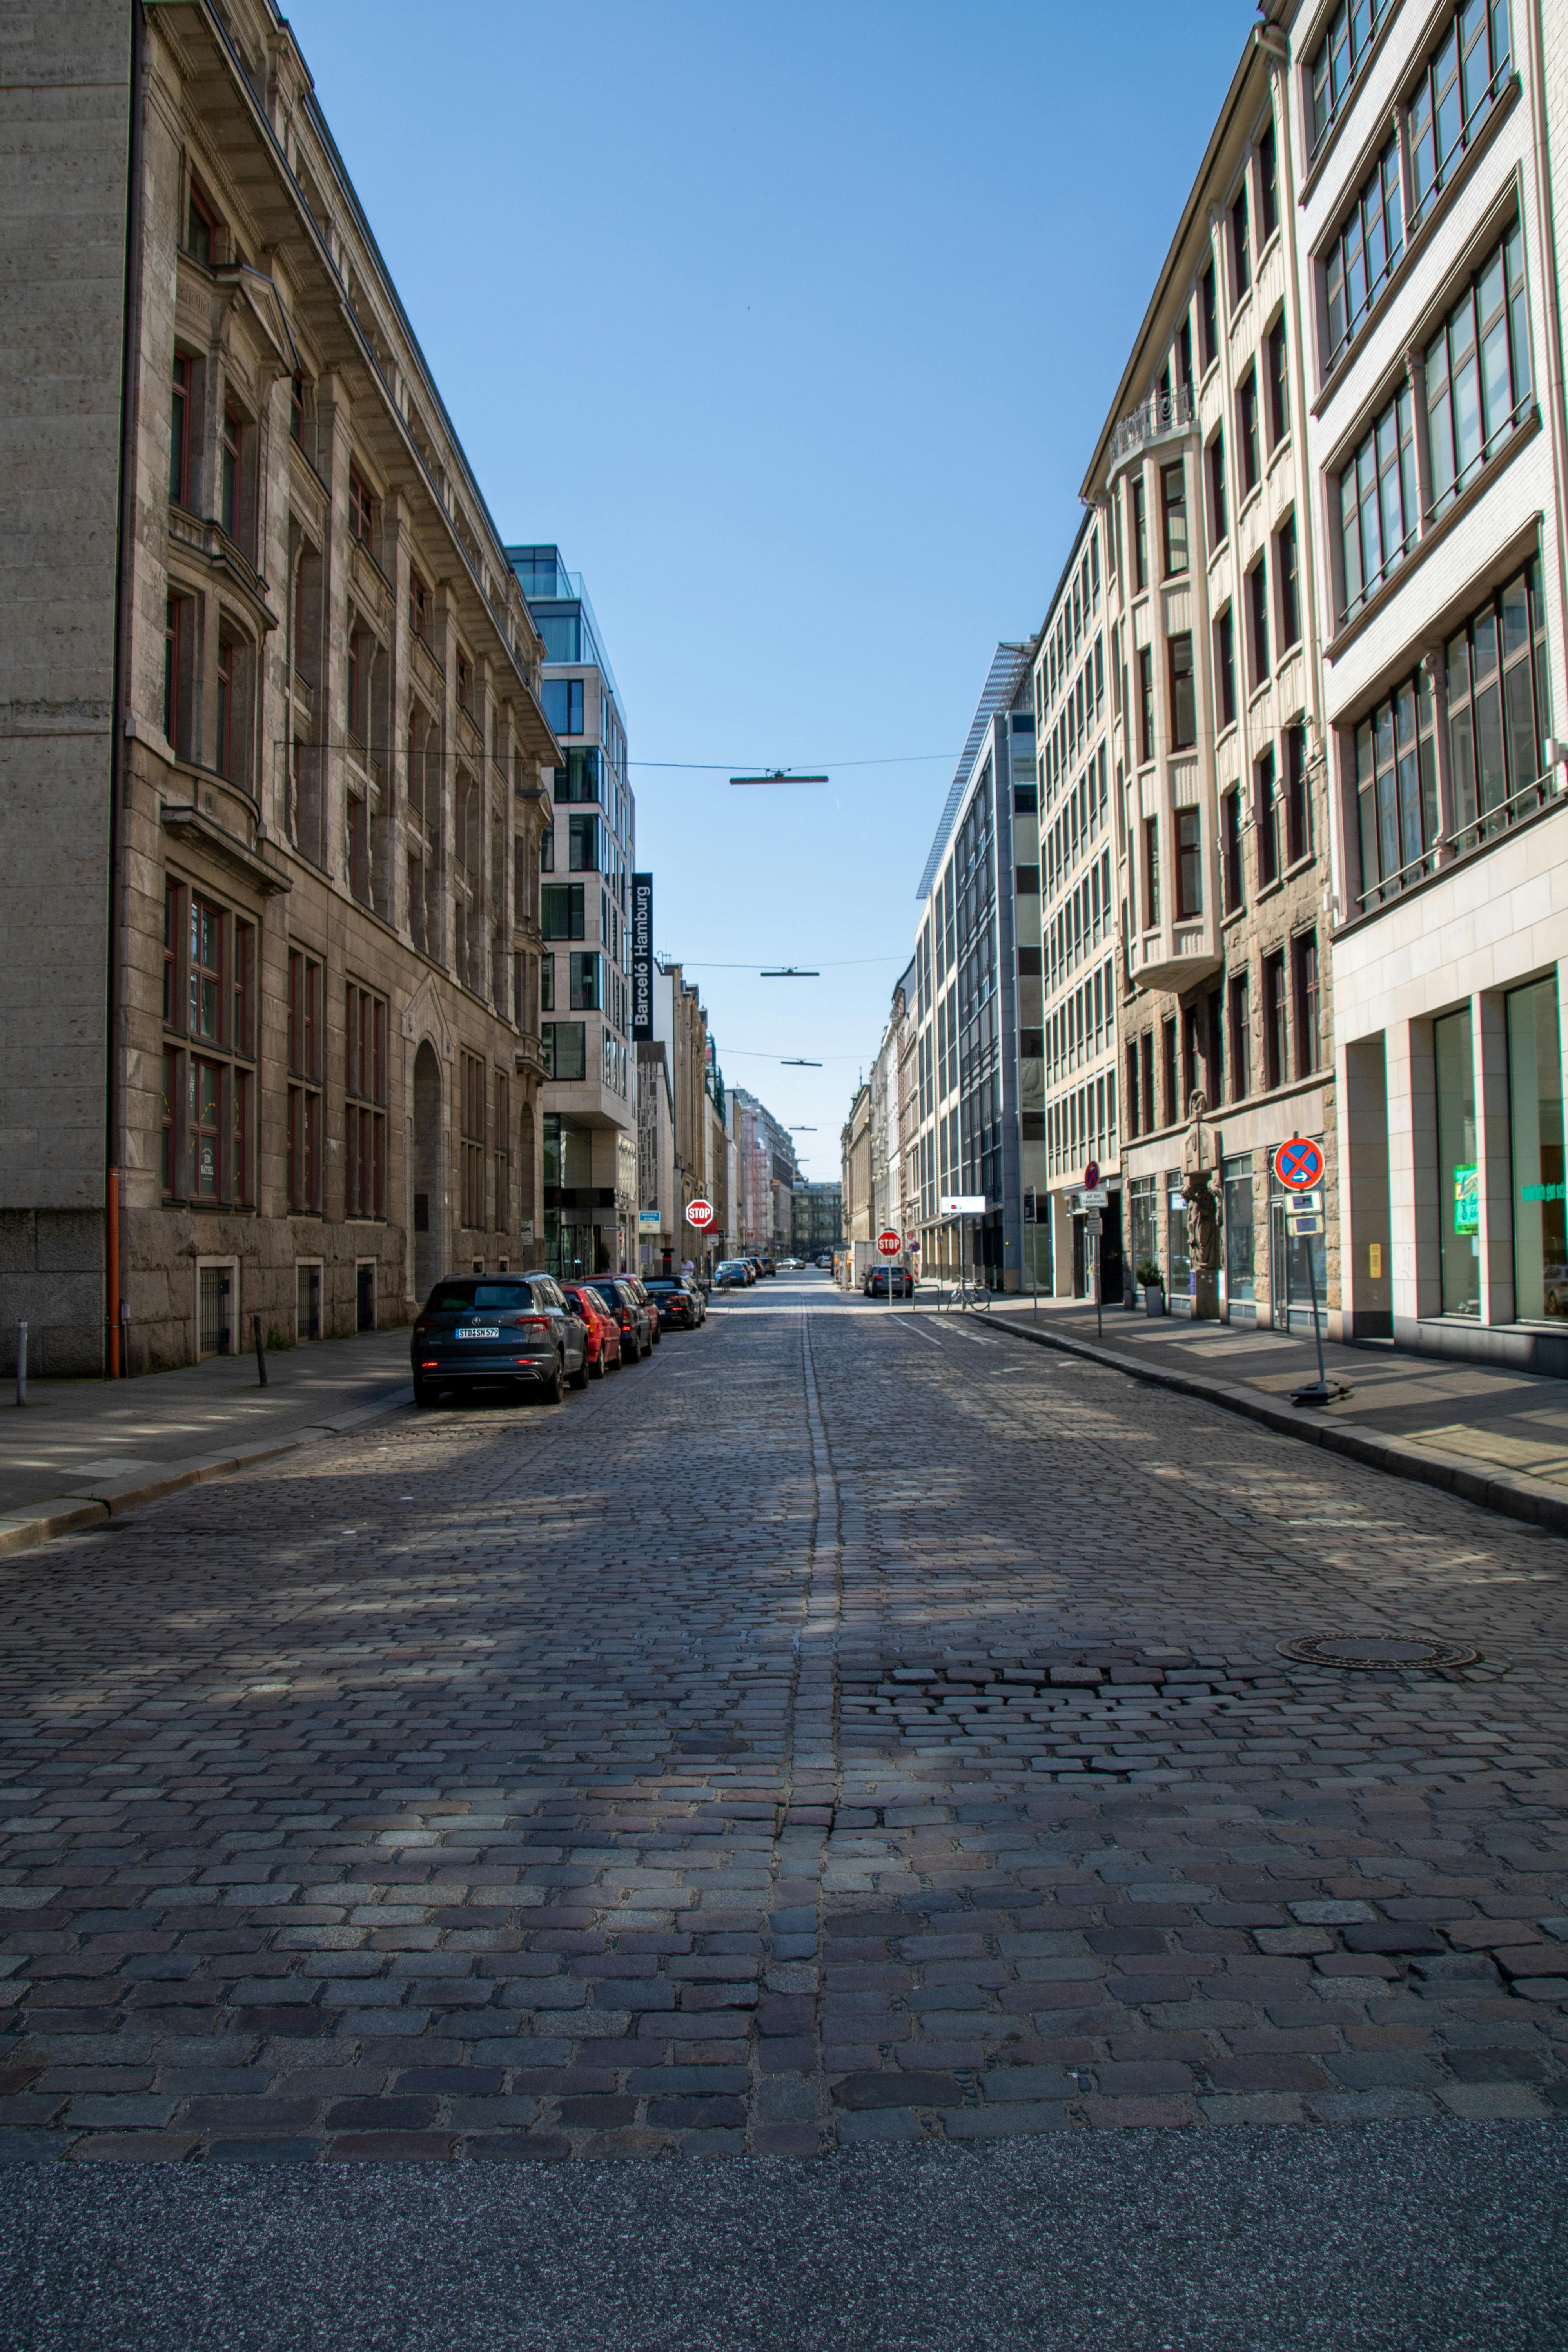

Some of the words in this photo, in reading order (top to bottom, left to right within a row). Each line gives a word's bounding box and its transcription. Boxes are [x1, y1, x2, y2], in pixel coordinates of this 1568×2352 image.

[634, 886, 650, 956] Hamburg
[634, 962, 648, 1026] Barceló
[201, 1164, 214, 1175] RÄTSEL
[689, 1207, 710, 1219] STOP
[878, 1239, 900, 1249] STOP
